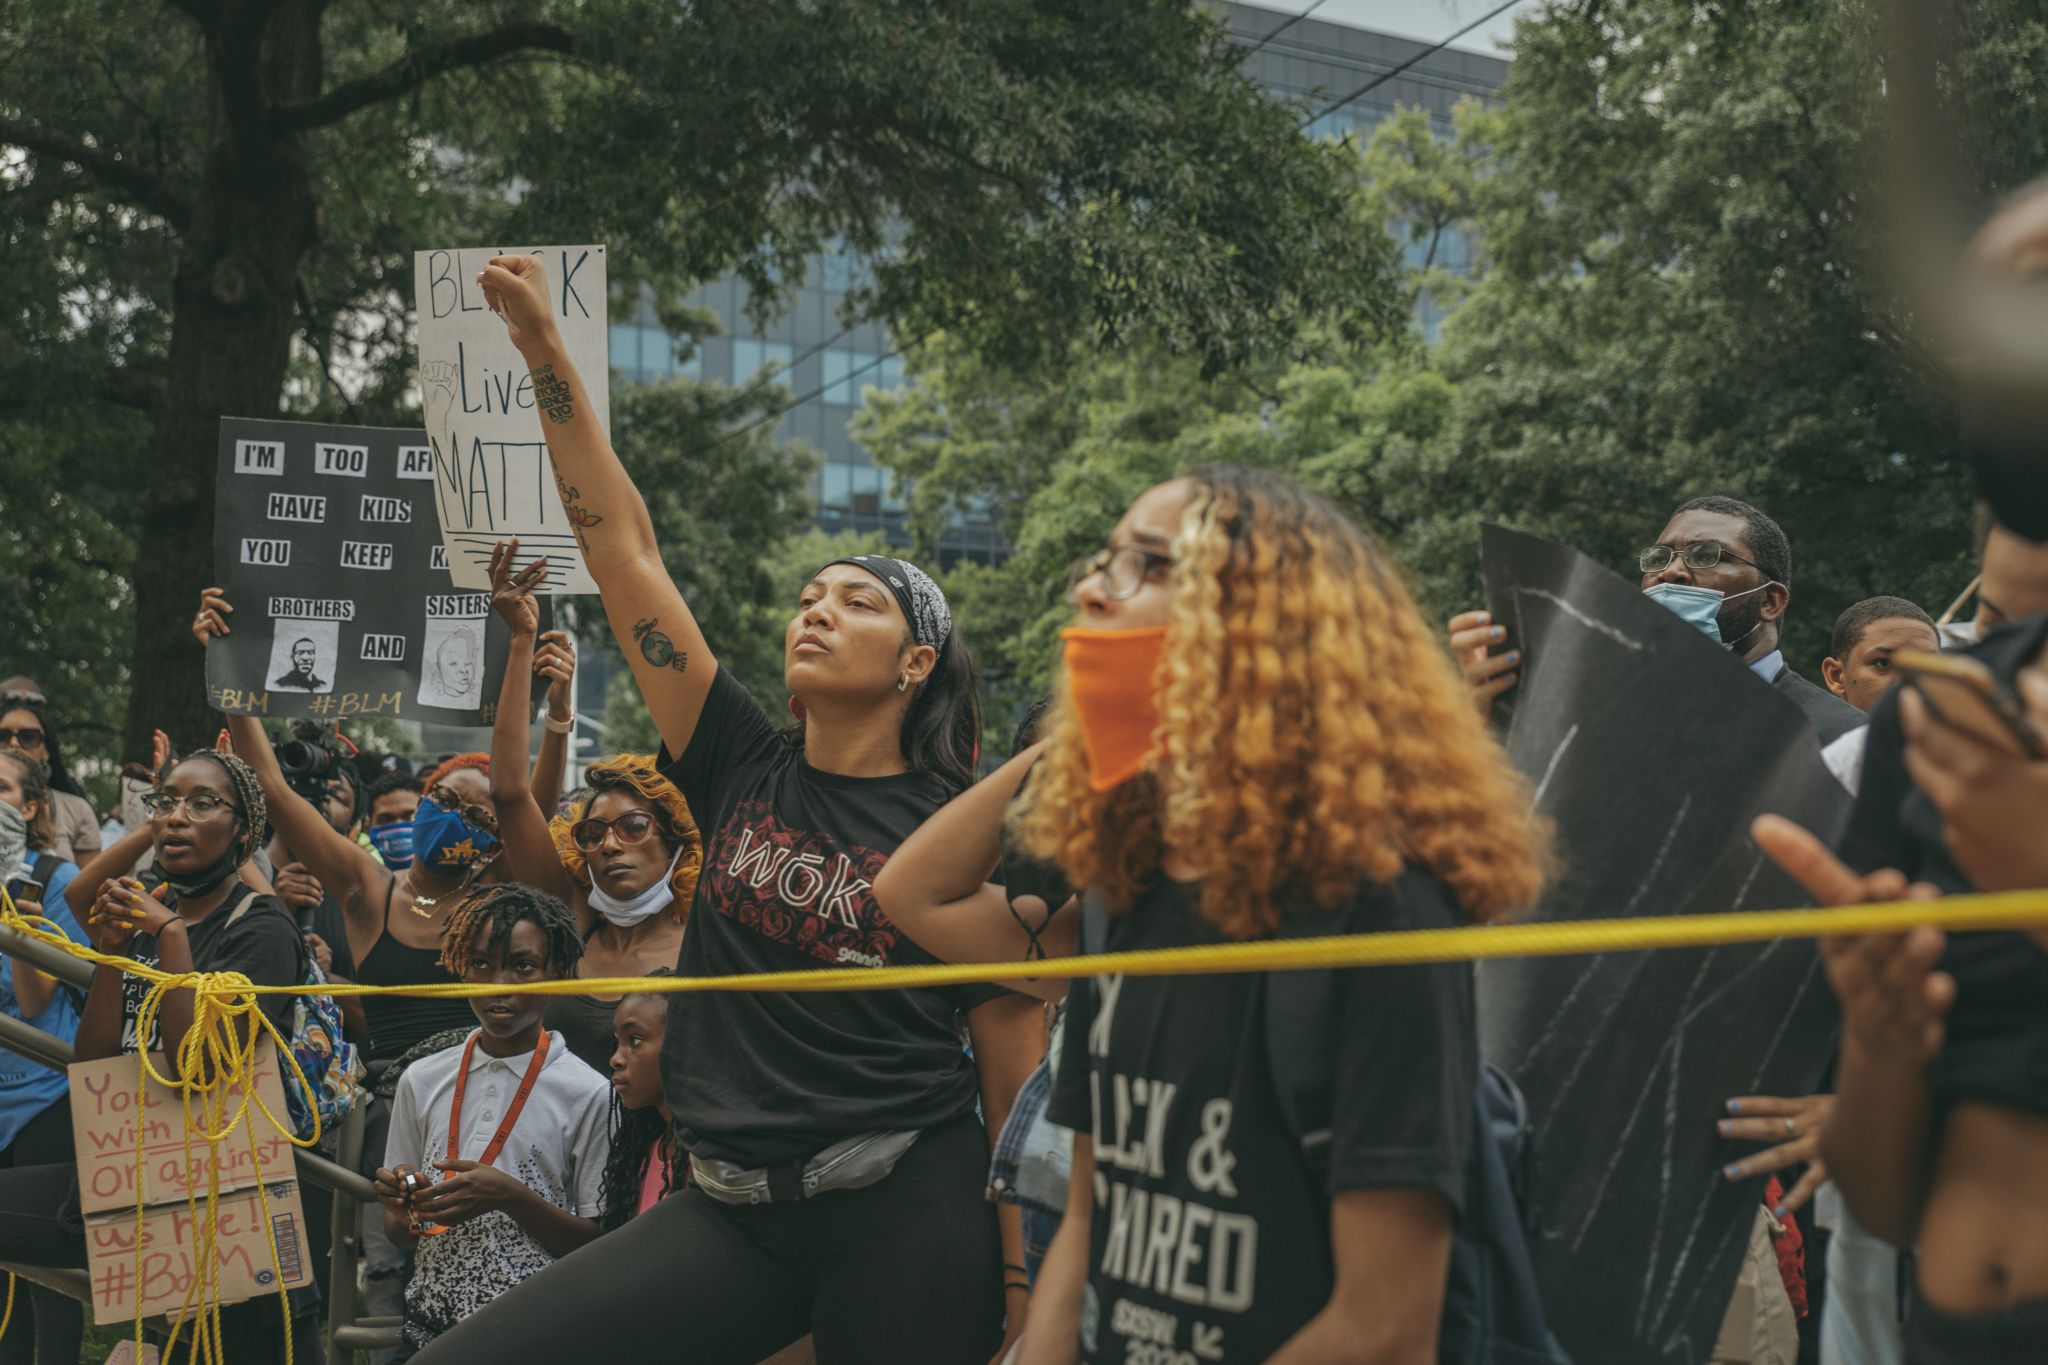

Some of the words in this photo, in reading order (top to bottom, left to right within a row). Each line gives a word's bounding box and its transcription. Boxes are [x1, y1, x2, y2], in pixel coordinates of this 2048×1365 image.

[428, 250, 589, 319] BLK
[458, 342, 536, 415] Live
[244, 446, 276, 469] I'M
[323, 448, 364, 473] TOO
[431, 431, 548, 531] MATT
[271, 495, 325, 522] HAVE
[363, 498, 410, 522] KIDS
[247, 540, 288, 564] YOU
[343, 545, 392, 568] KEEP
[271, 599, 351, 619] BROTHERS
[427, 595, 491, 616] SISTERS
[362, 636, 404, 658] AND
[308, 691, 402, 715] #BLM
[84, 1072, 162, 1117] You
[87, 1117, 170, 1151] with
[1186, 1096, 1239, 1198] &
[93, 1221, 154, 1249] us
